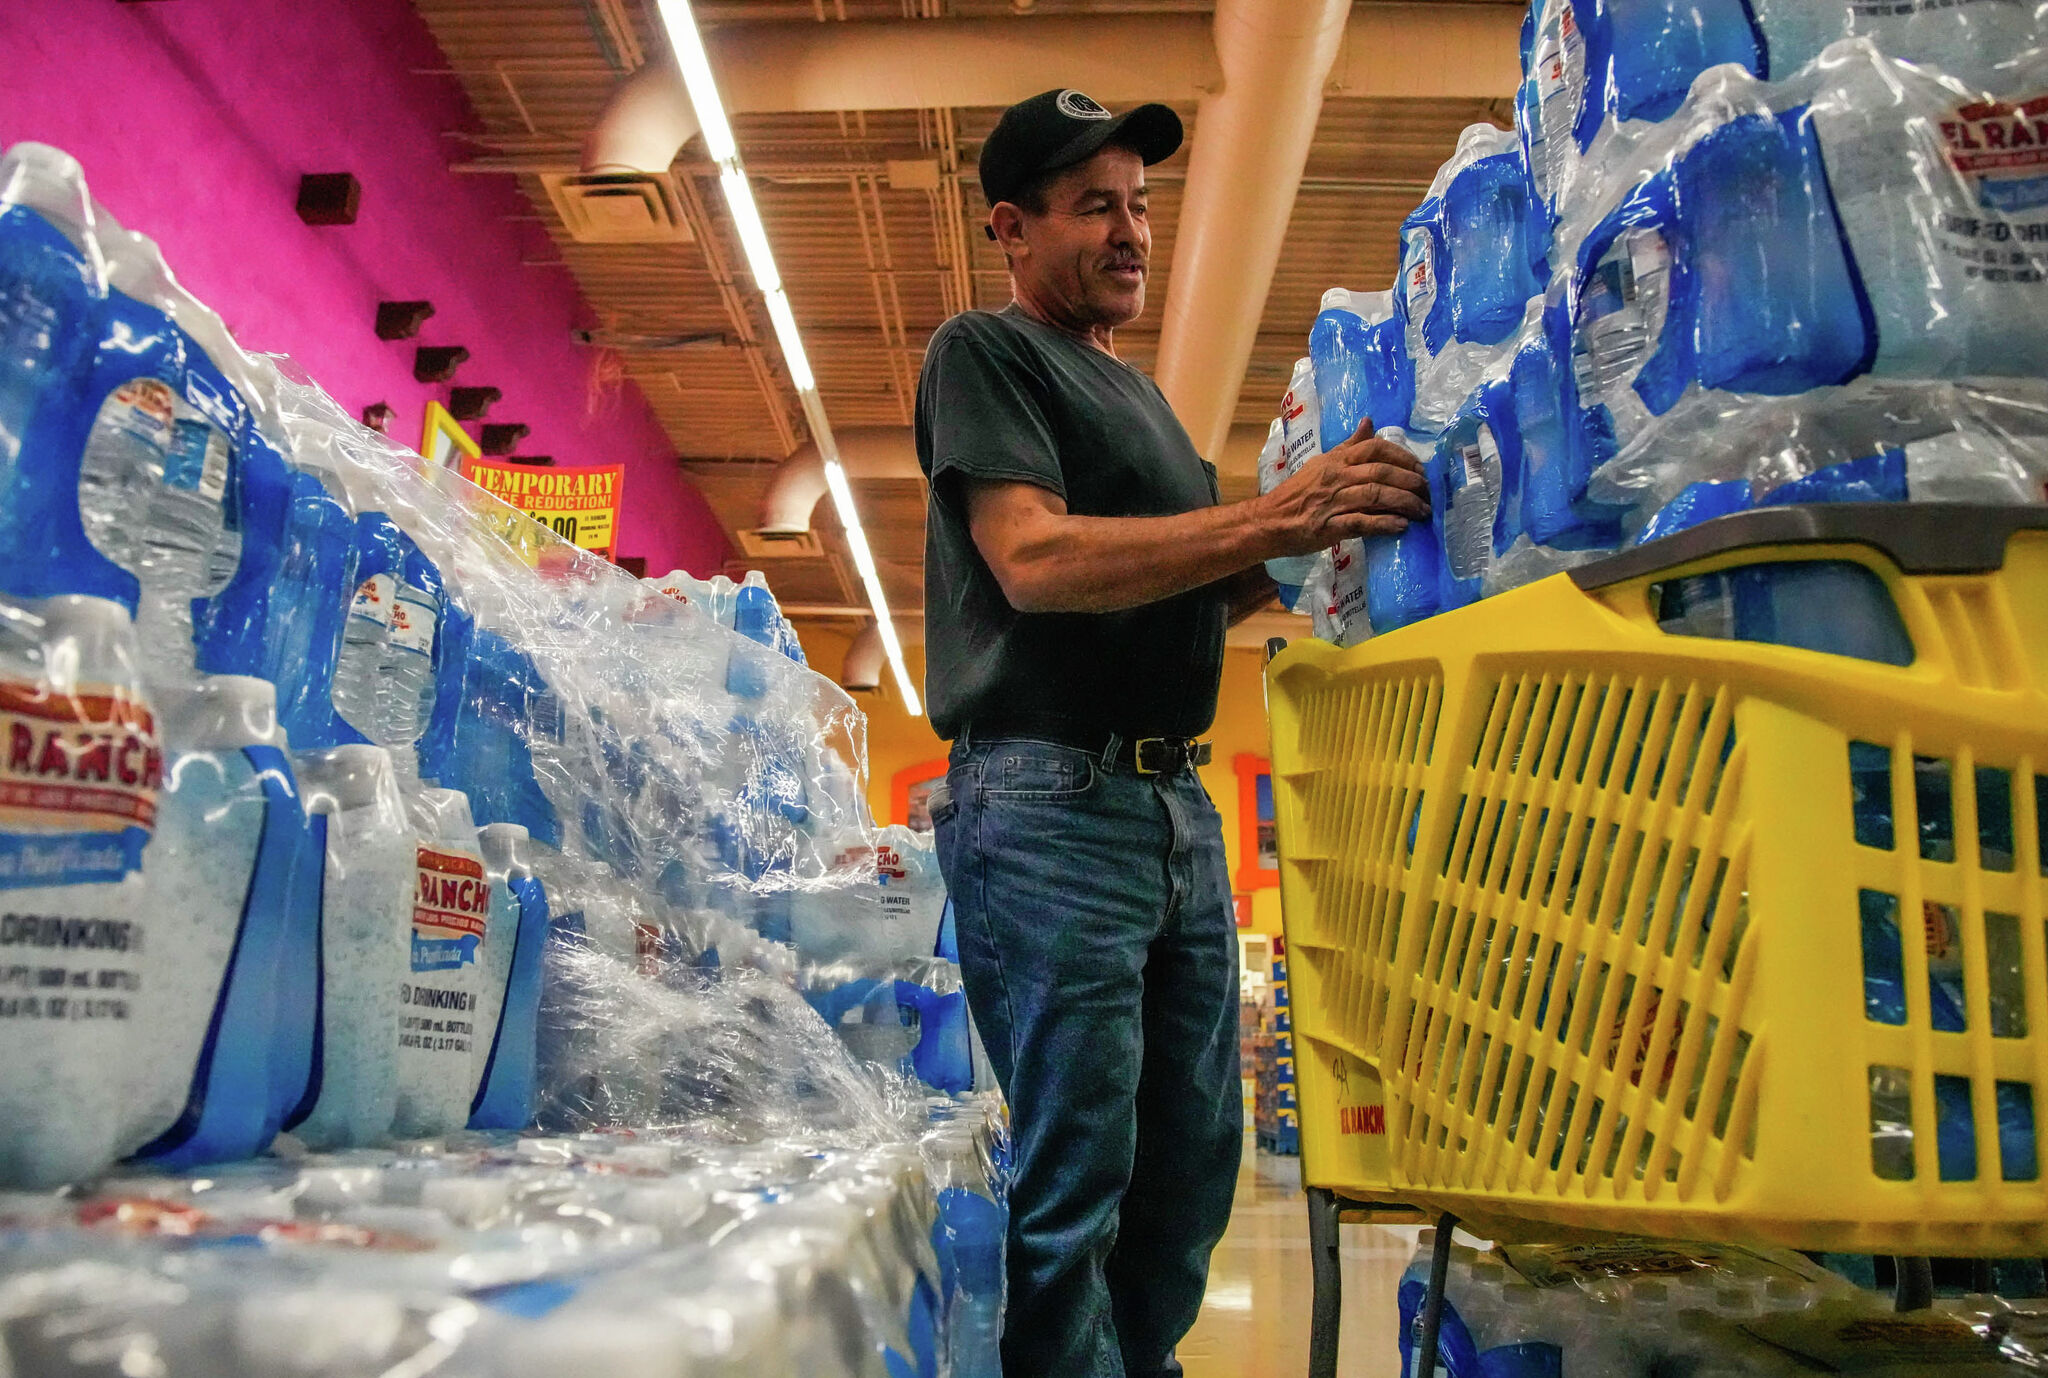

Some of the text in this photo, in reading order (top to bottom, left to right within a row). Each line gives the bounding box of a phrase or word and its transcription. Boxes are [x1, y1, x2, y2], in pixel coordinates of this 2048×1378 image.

[1290, 429, 1314, 453] WATER
[471, 465, 617, 497] TEMPORARY
[524, 494, 612, 510] REDUCTION!
[1340, 586, 1363, 609] WATER
[419, 872, 491, 914] RANCH
[886, 896, 911, 905] WATER
[0, 913, 130, 951] DRINKING
[413, 986, 468, 1011] DRINKING
